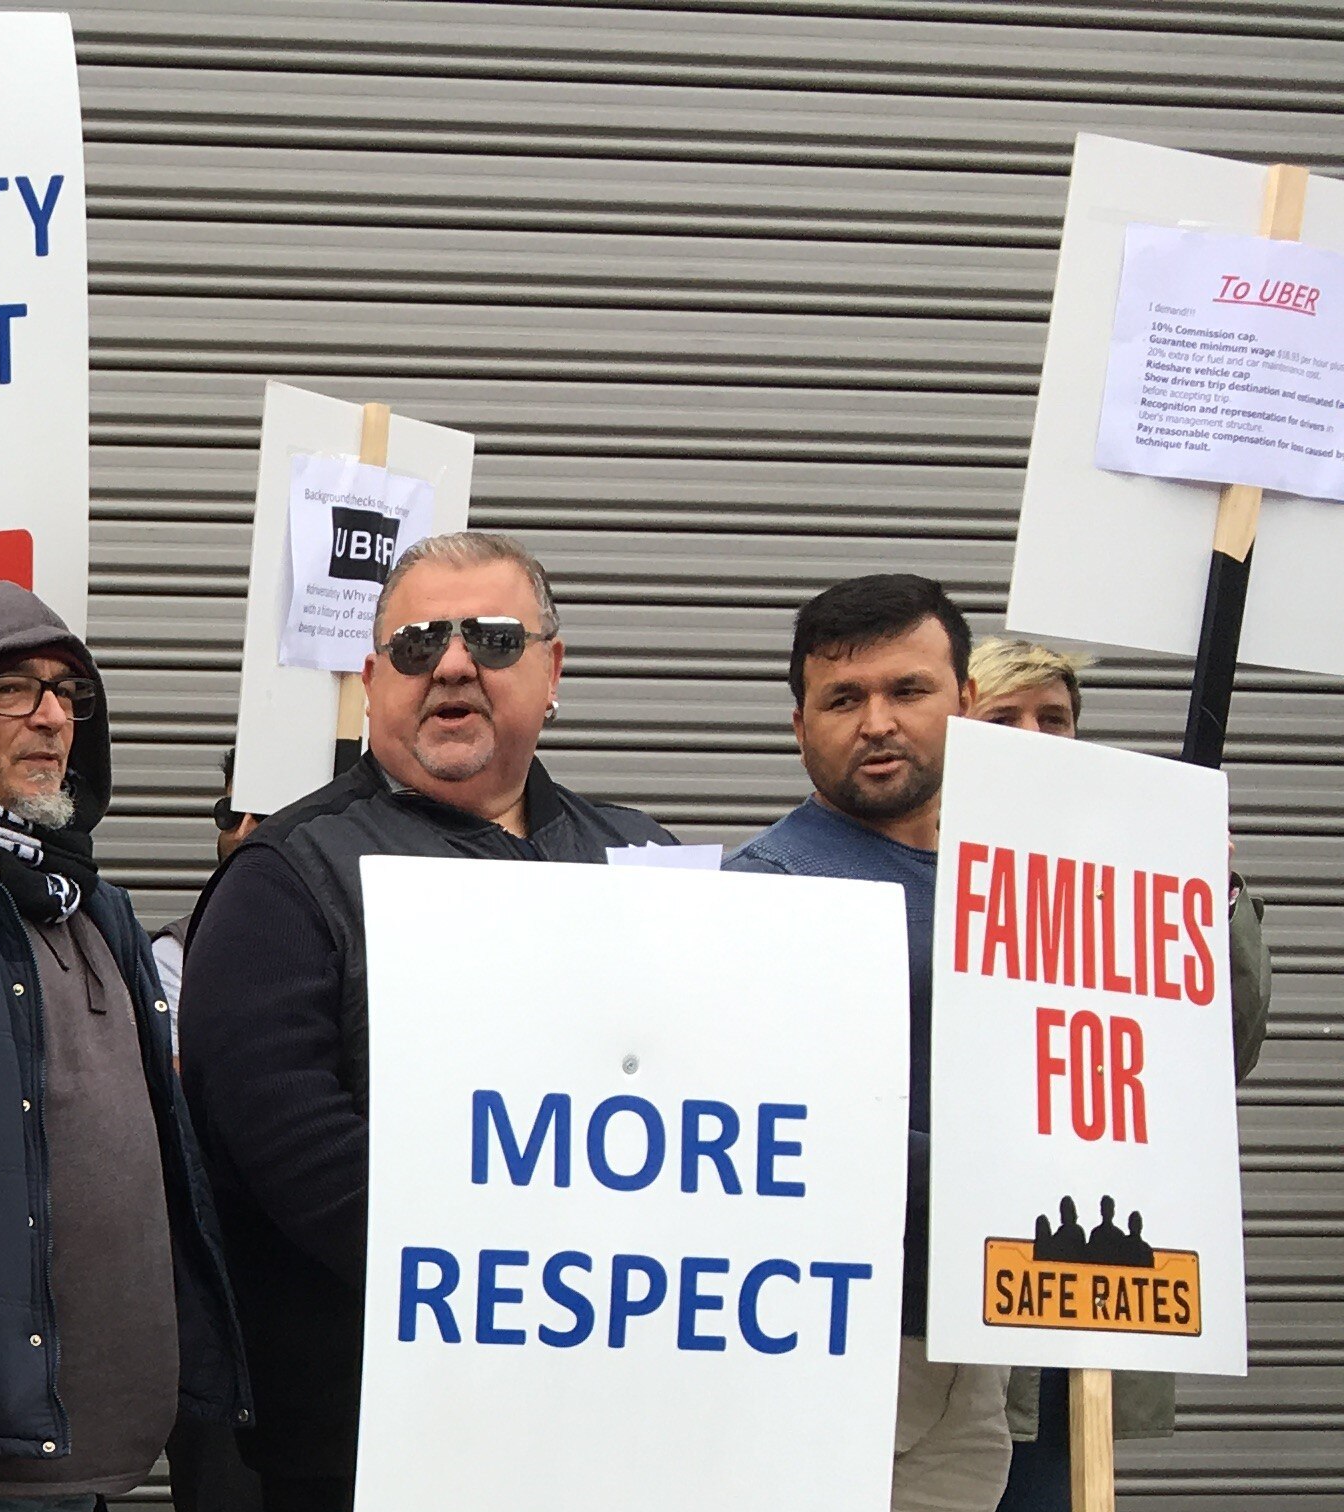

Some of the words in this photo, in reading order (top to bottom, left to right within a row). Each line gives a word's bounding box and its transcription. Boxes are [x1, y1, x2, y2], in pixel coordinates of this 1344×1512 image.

[1218, 275, 1250, 300] To
[1259, 278, 1321, 311] UBER
[1152, 321, 1172, 333] 10%
[1175, 325, 1234, 339] Commission
[1237, 333, 1258, 343] cap.
[1147, 346, 1166, 358] 20%
[1168, 351, 1189, 361] extra
[1192, 353, 1204, 362] for
[1207, 354, 1224, 365] fuel
[1226, 356, 1243, 366] and
[1246, 359, 1260, 367] car
[1150, 334, 1197, 349] Guarantee
[1200, 341, 1248, 354] minimum
[1251, 347, 1275, 358] wage
[1146, 359, 1192, 374] Rideshare
[1195, 367, 1230, 378] vehicle
[1232, 370, 1250, 380] cap
[1142, 384, 1168, 396] before
[1170, 390, 1211, 403] accepting
[1144, 372, 1169, 383] Show
[1171, 376, 1205, 388] drivers
[1208, 380, 1226, 391] trip
[1228, 380, 1280, 396] destination
[1138, 410, 1163, 422] Uber's
[1166, 415, 1223, 428] management
[1140, 397, 1196, 412] Recognition
[1199, 405, 1218, 414] and
[1221, 406, 1286, 423] representation
[1288, 415, 1299, 425] for
[1136, 436, 1182, 450] technique
[1137, 422, 1154, 435] Pay
[1155, 426, 1210, 439] reasonable
[1212, 432, 1276, 447] compensation
[1278, 439, 1289, 449] for
[1305, 447, 1333, 458] caused
[305, 488, 350, 504] Background
[343, 589, 366, 603] Why
[342, 606, 355, 619] of
[953, 841, 1215, 1007] FAMILIES
[1035, 1006, 1149, 1145] FOR
[470, 1089, 808, 1198] MORE
[396, 1245, 874, 1357] RESPECT
[996, 1269, 1078, 1319] SAFE
[1092, 1273, 1191, 1325] RATES
